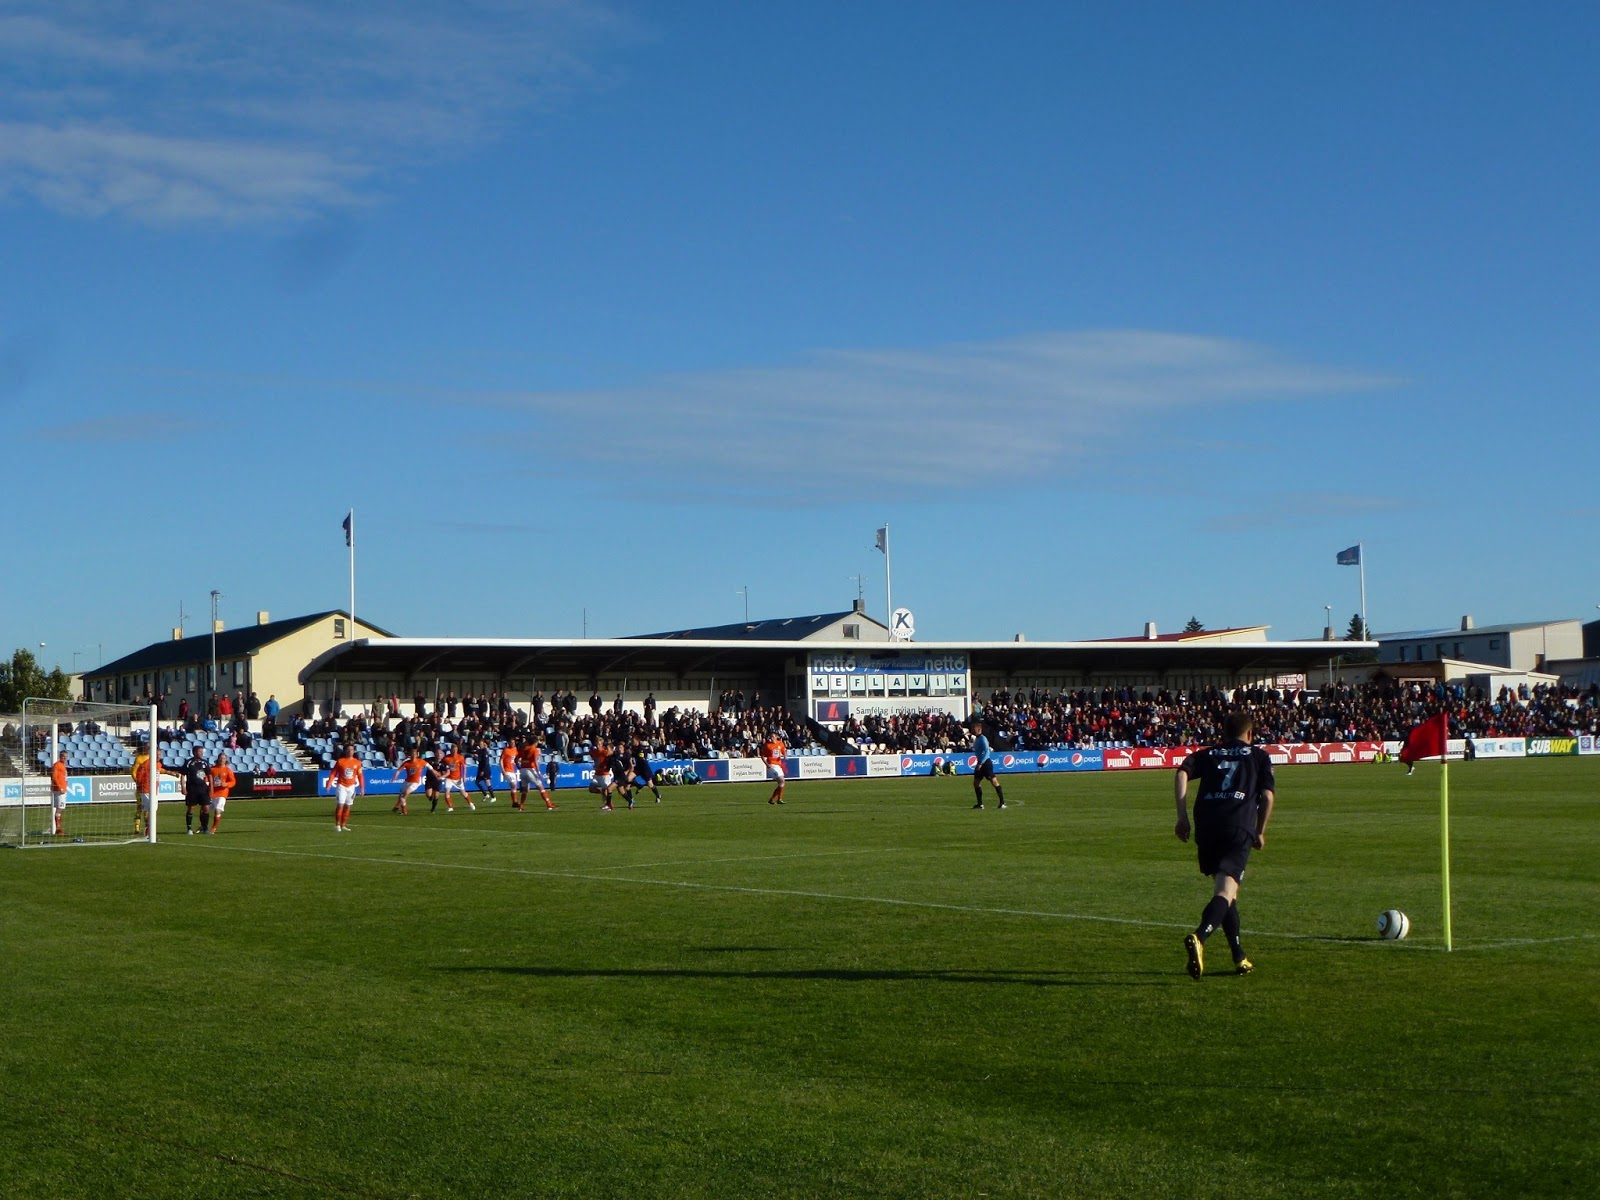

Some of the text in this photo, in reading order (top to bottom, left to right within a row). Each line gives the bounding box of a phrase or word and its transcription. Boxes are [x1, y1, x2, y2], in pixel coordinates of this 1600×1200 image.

[895, 612, 910, 629] K
[1527, 739, 1577, 754] SUBWAY
[913, 760, 930, 768] pepsi
[1015, 757, 1034, 765] pepsi
[1217, 760, 1240, 791] 7
